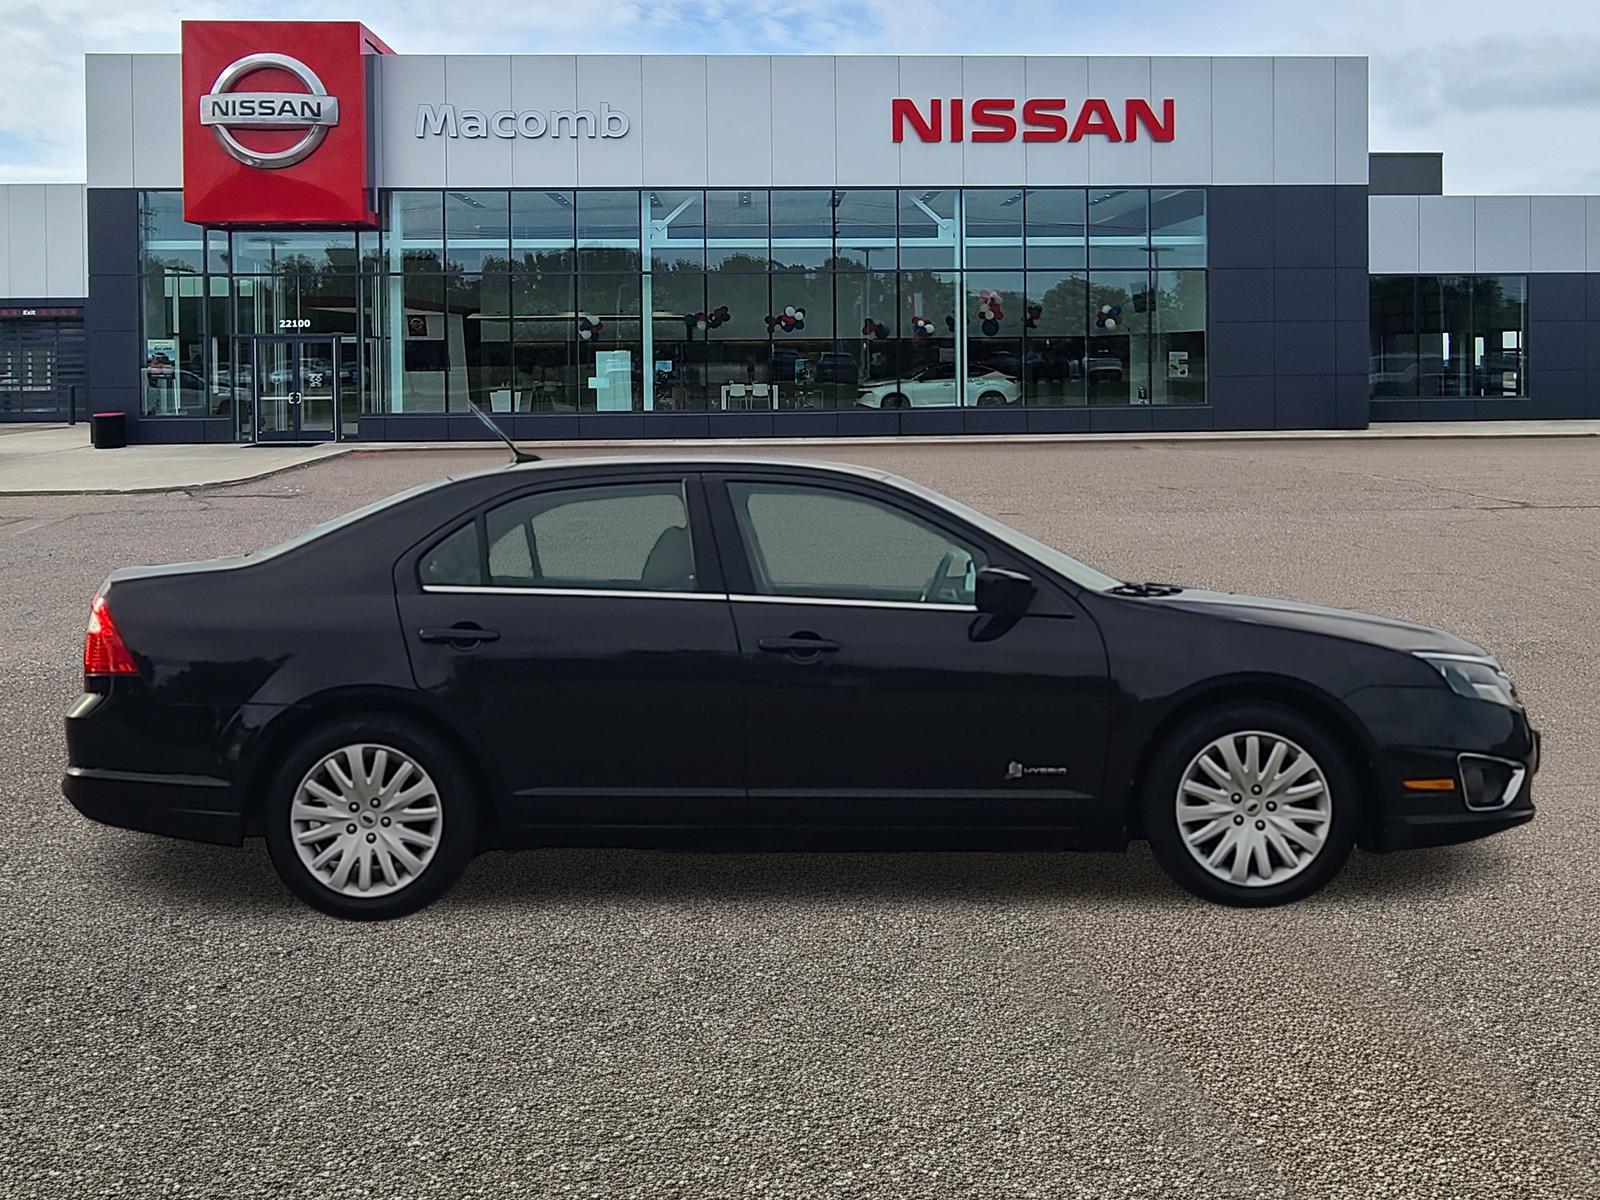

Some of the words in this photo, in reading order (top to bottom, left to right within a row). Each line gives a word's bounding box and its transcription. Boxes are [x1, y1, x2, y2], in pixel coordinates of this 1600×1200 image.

[211, 99, 323, 118] NISSAN
[415, 101, 631, 139] Macomb
[892, 98, 1175, 142] NISSAN
[279, 319, 311, 328] 22100
